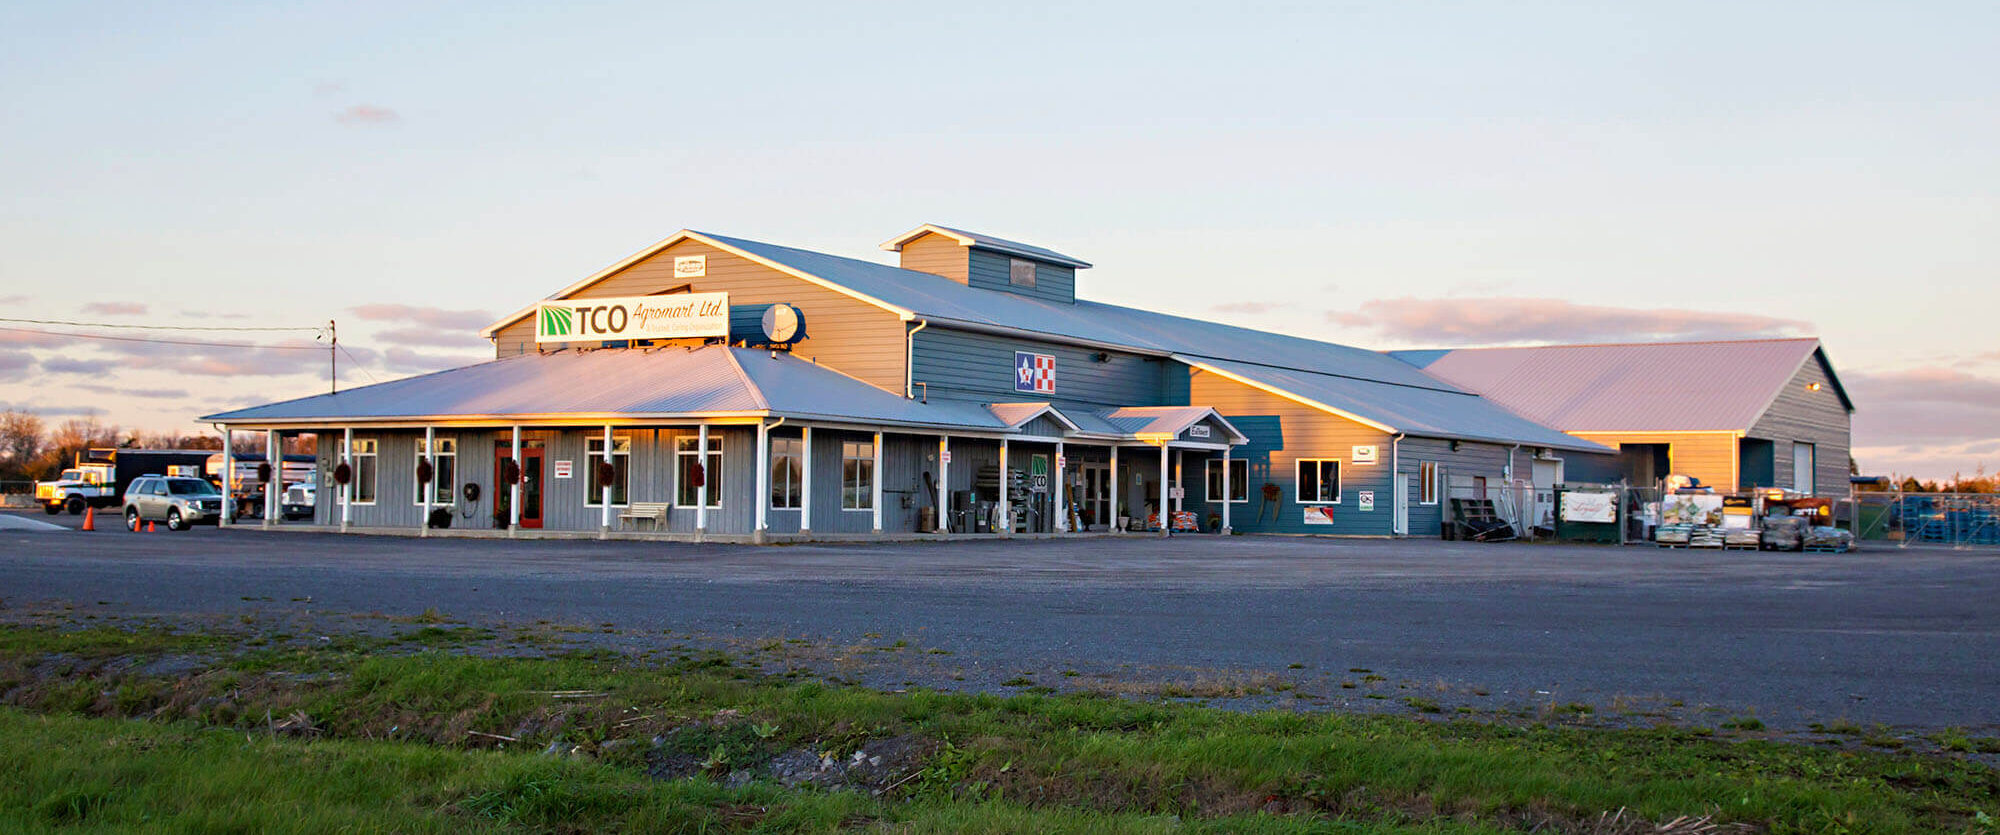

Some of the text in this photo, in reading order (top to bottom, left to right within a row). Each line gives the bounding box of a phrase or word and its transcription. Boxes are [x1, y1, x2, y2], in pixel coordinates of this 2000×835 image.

[575, 305, 628, 335] TCO
[633, 302, 694, 329] Agromart
[699, 299, 723, 317] Ltd.
